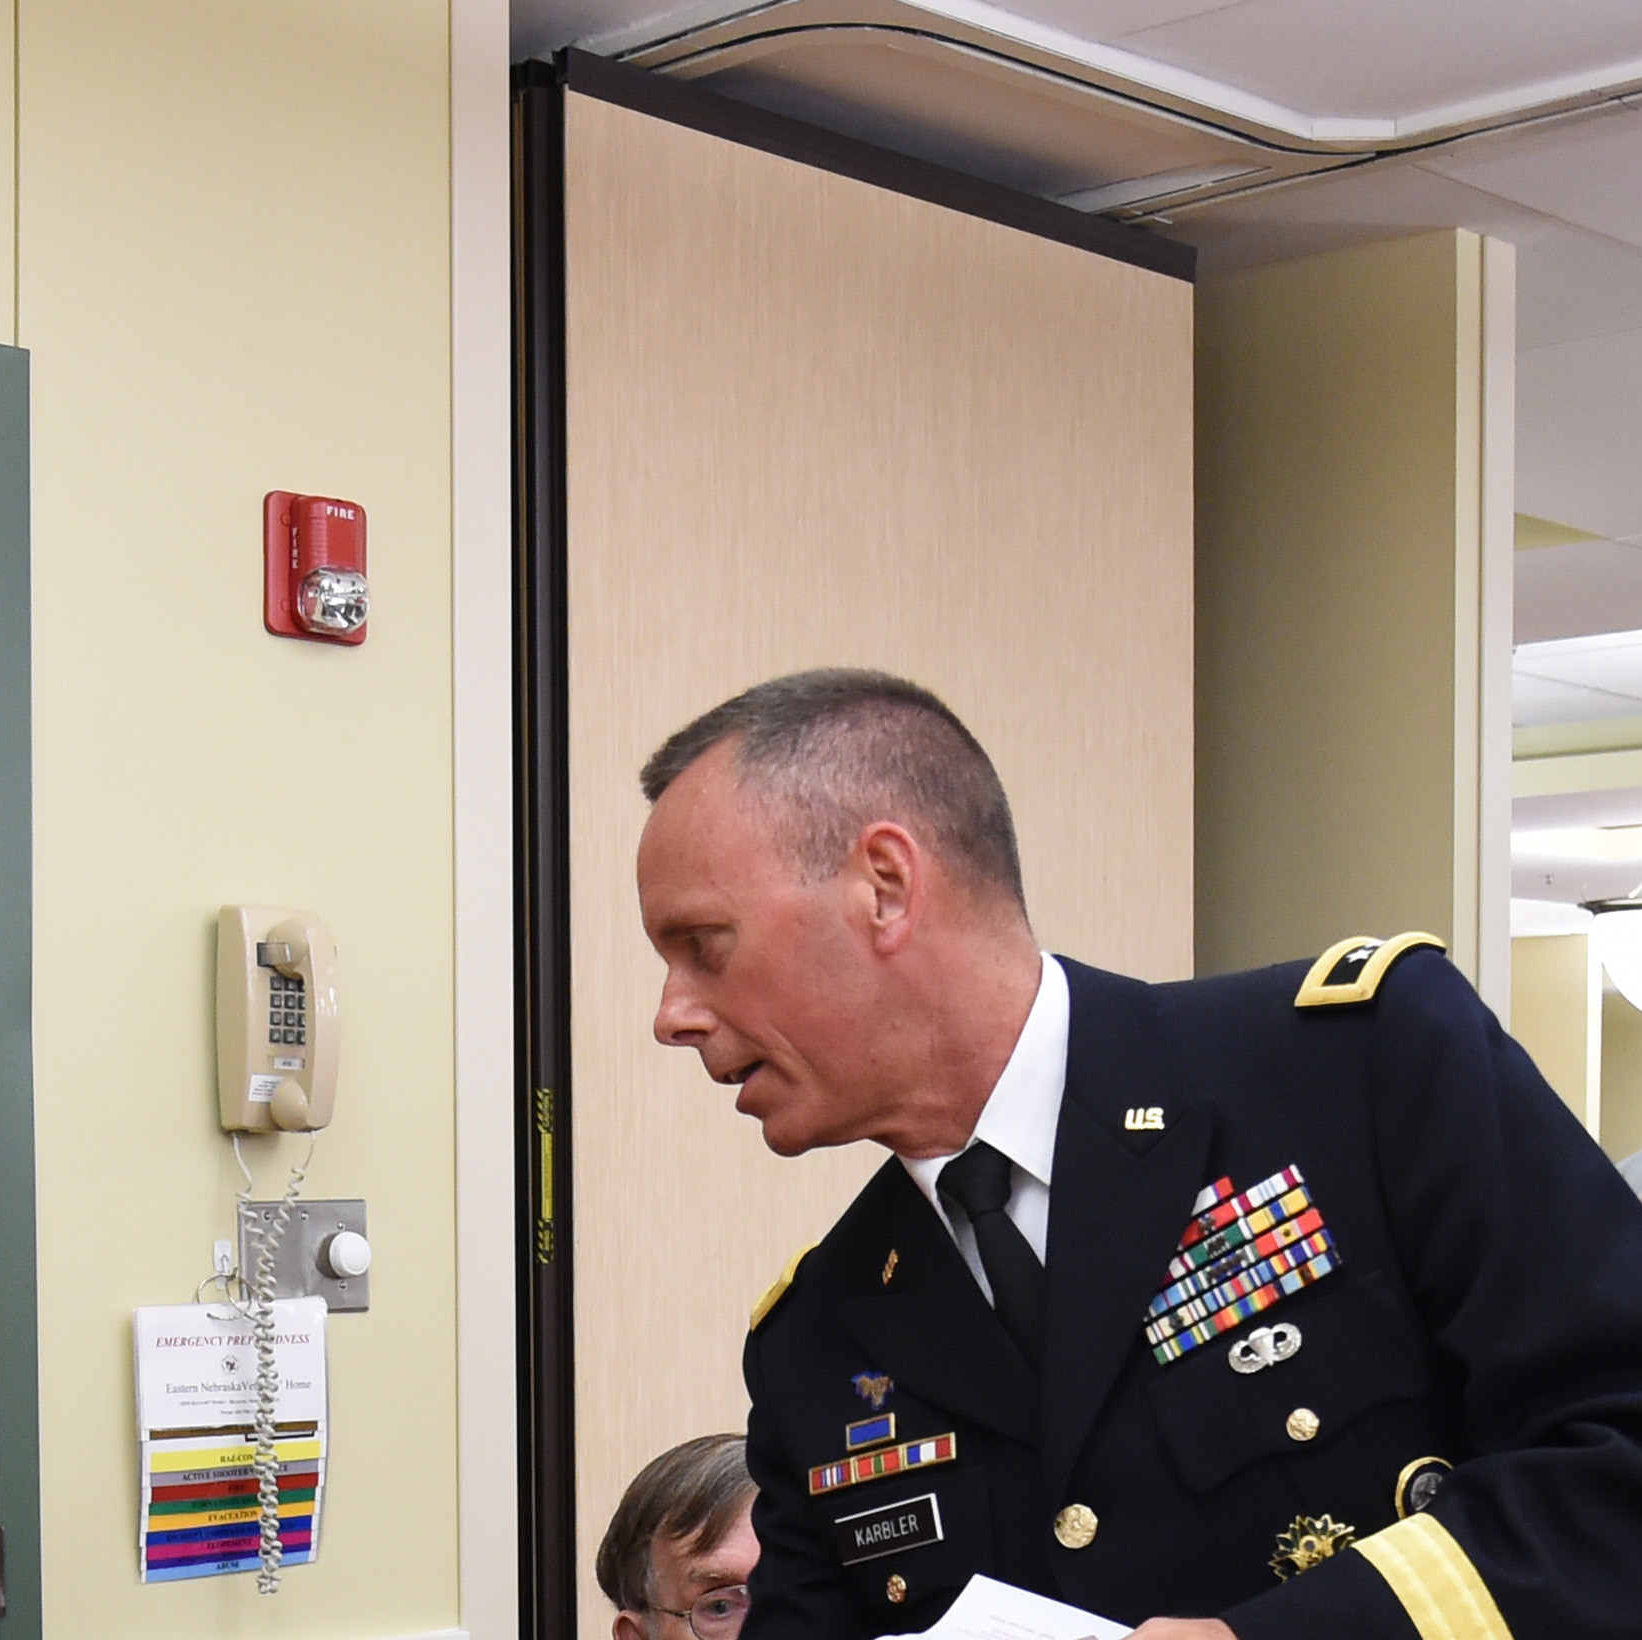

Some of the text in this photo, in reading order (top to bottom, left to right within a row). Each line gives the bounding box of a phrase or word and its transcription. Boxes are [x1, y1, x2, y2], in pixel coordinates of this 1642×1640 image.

[326, 505, 355, 520] FIRE
[156, 1334, 311, 1348] EMERGENCY PREPDNESS
[166, 1383, 198, 1394] Eastern
[285, 1379, 312, 1390] Home
[854, 1513, 919, 1547] KARBLER
